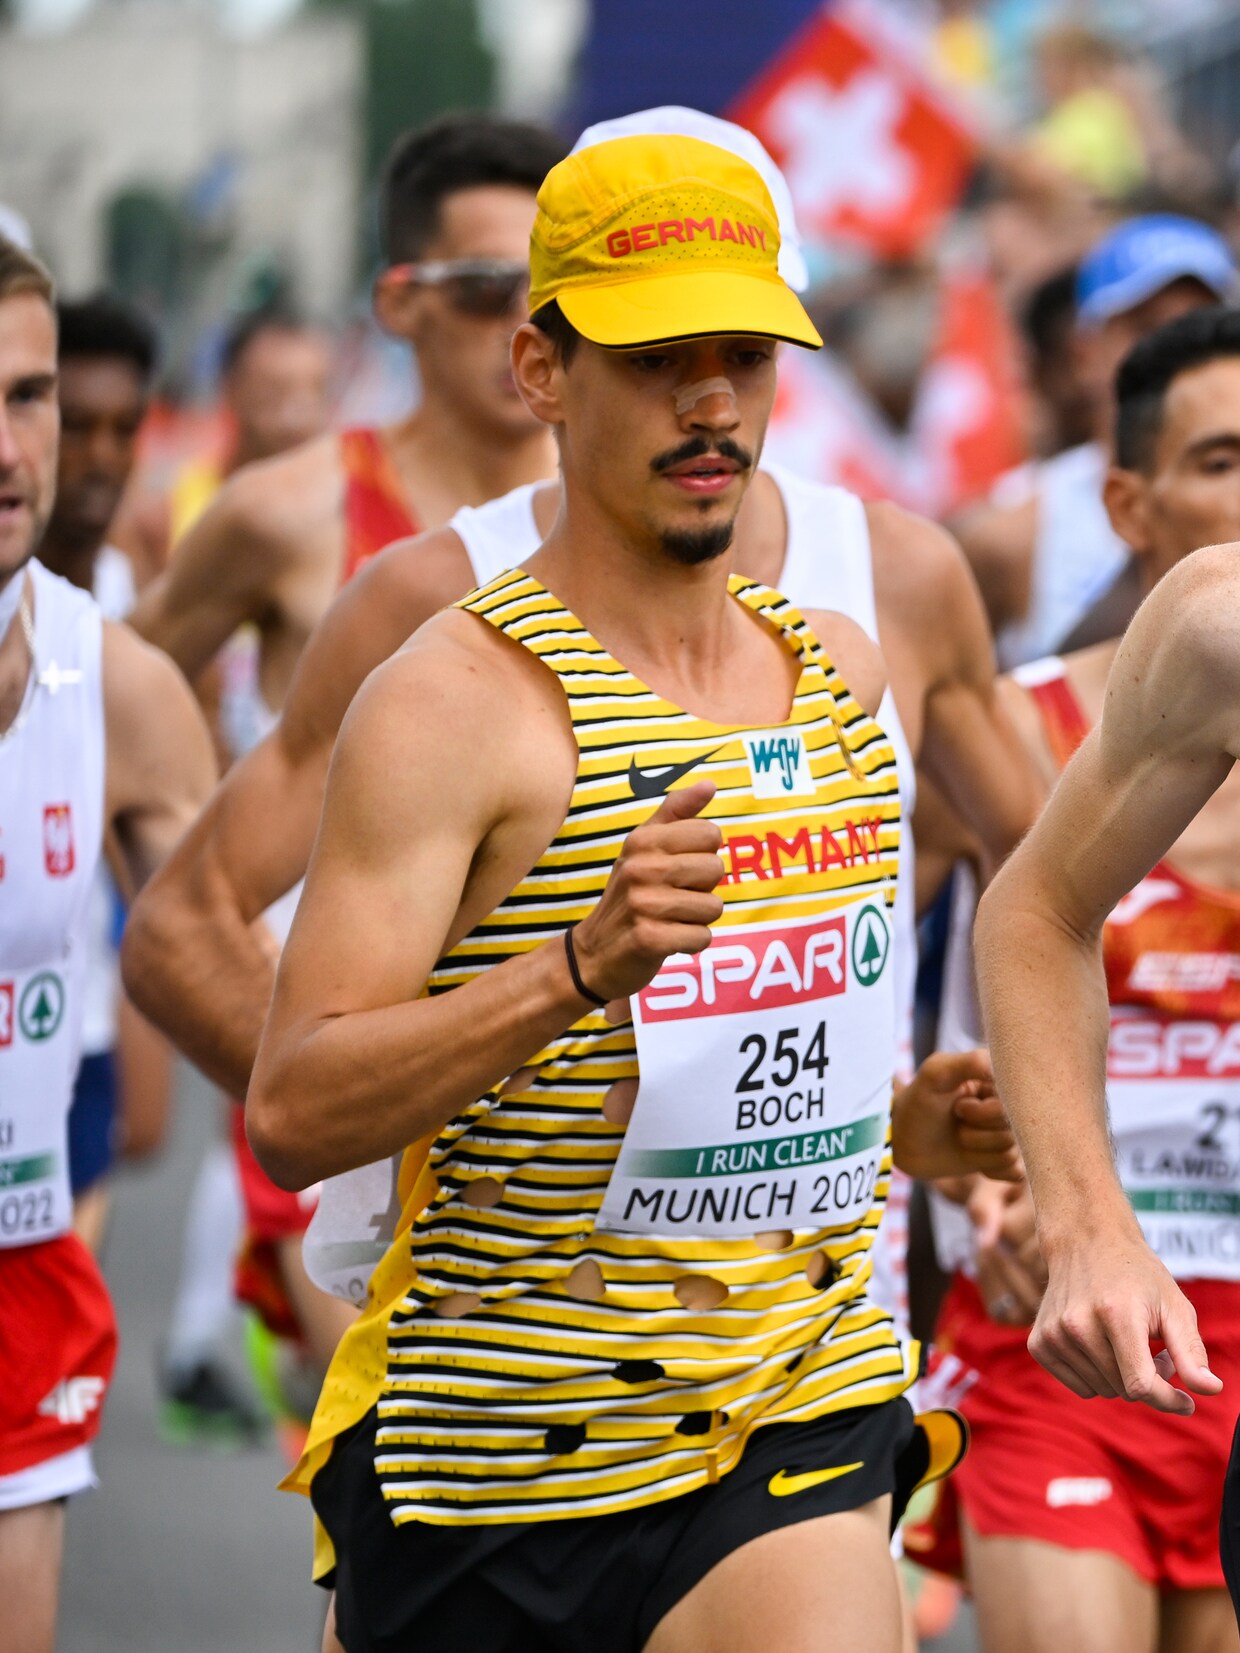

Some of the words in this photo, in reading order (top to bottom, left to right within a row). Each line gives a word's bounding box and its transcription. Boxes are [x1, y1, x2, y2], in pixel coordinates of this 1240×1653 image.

[606, 216, 766, 258] GERMANY
[718, 815, 882, 886] RMANY
[645, 928, 844, 1011] SPAR
[735, 1020, 829, 1094] 254
[736, 1087, 825, 1130] BOCH
[696, 1150, 704, 1174] I
[711, 1143, 767, 1174] RUN
[623, 1179, 797, 1223] MUNICH
[810, 1160, 876, 1214] 2022
